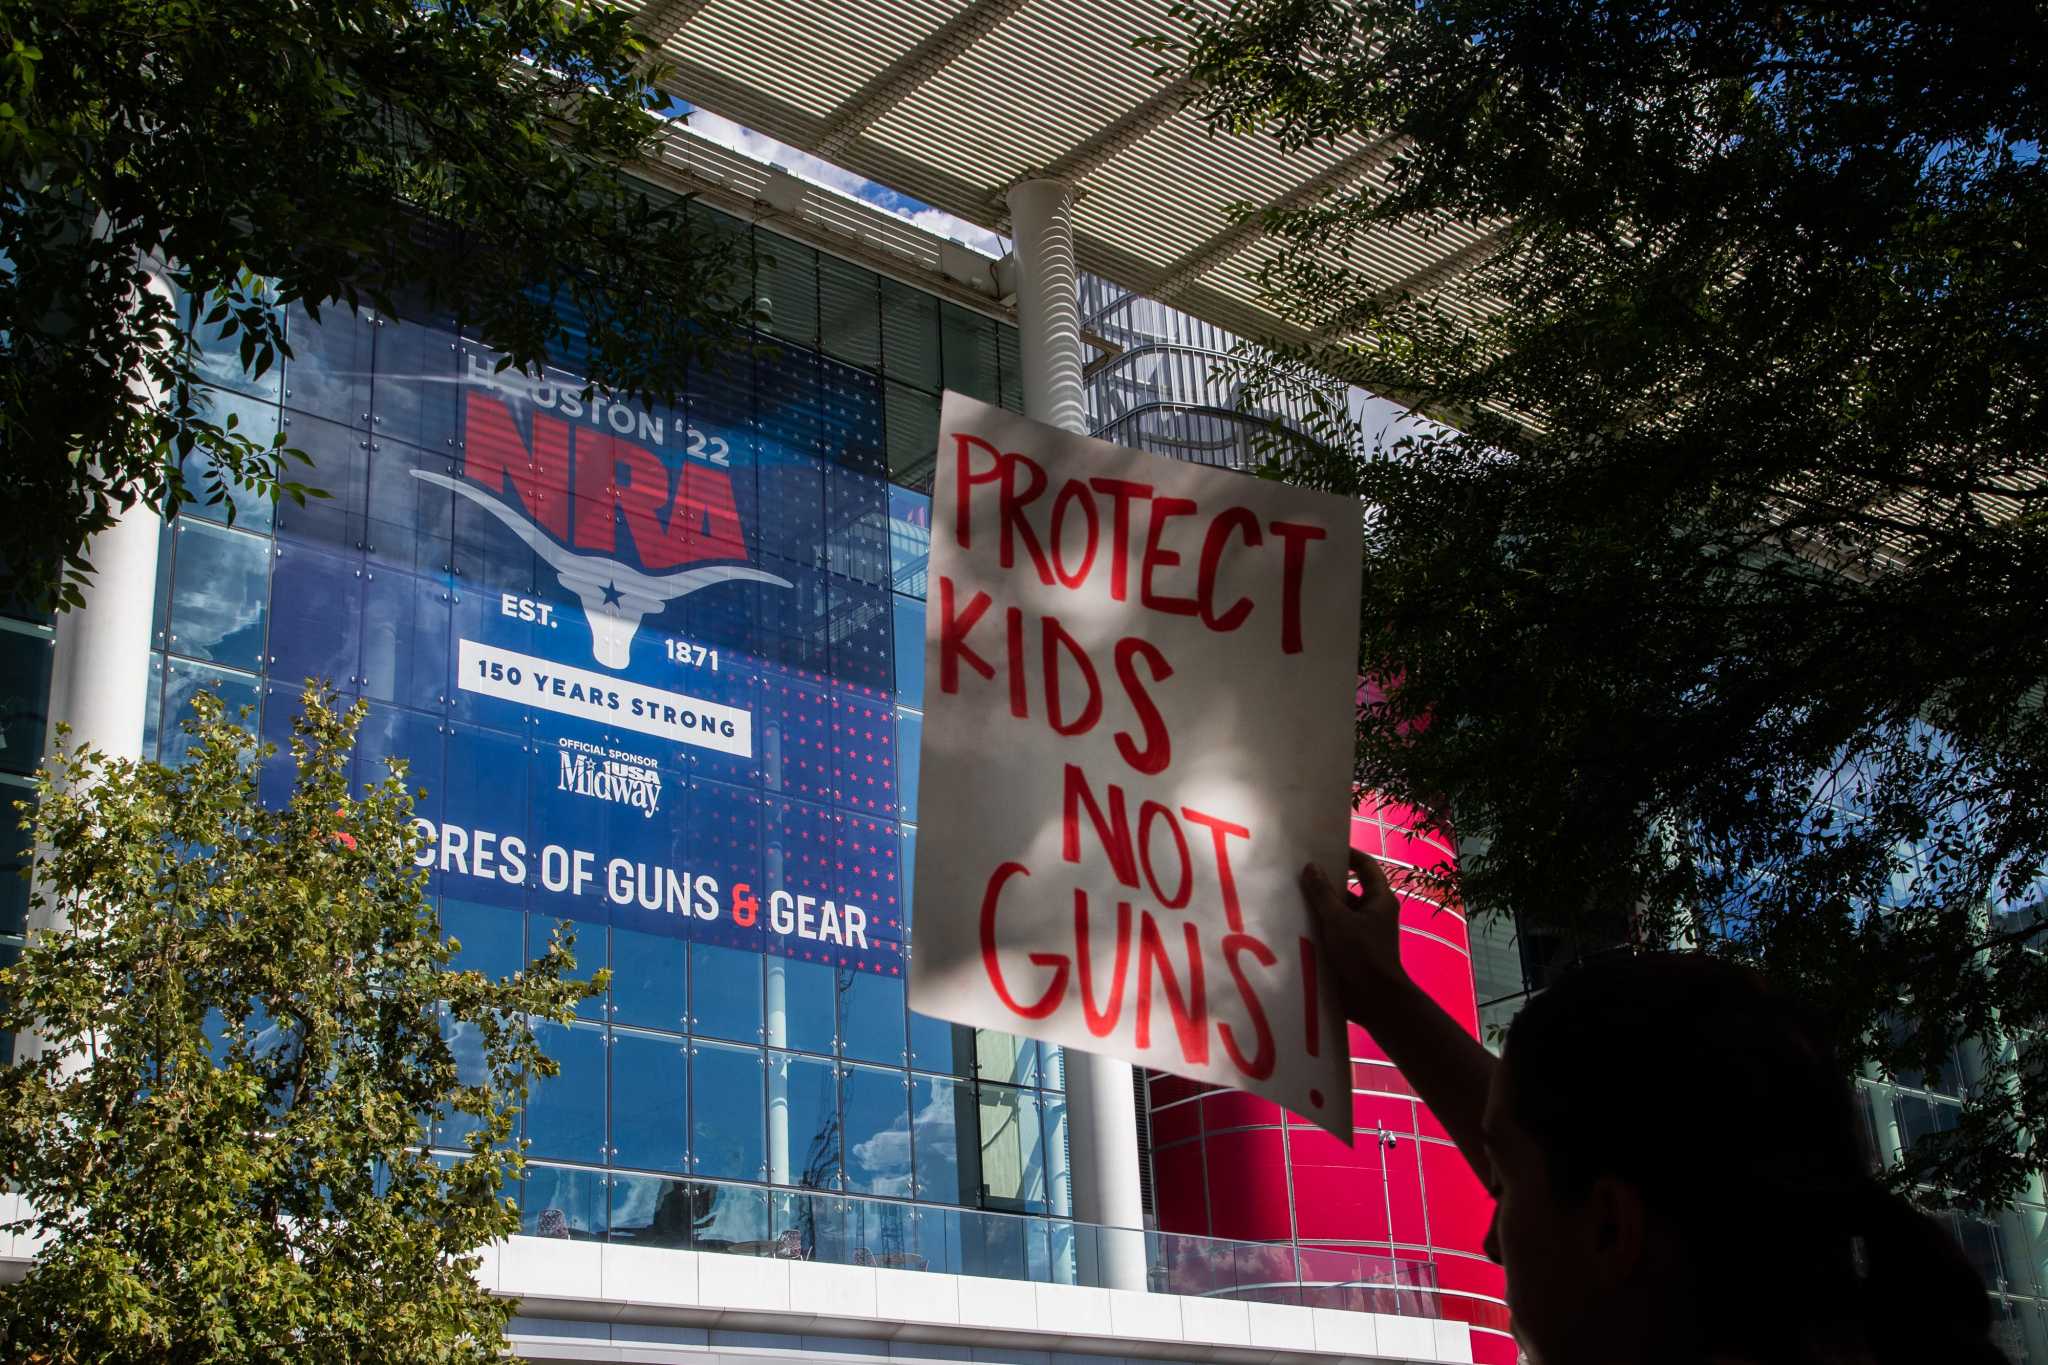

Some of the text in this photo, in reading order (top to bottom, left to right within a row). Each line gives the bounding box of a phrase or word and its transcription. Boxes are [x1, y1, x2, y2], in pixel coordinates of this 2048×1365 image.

[464, 390, 748, 568] NRA
[950, 433, 1327, 655] PROTECT
[502, 594, 558, 629] EST.
[665, 639, 719, 671] 1871
[938, 576, 1171, 775] KIDS
[478, 660, 736, 738] 150 YEARS STRONG
[559, 737, 658, 769] OFFICIAL SPONSOR
[611, 762, 661, 785] USA
[400, 817, 527, 885] CRES
[540, 844, 595, 896] OF
[607, 857, 719, 921] GUNS
[732, 883, 758, 927] &
[769, 889, 869, 950] GEAR
[1063, 763, 1250, 933] NOT
[979, 861, 1325, 1109] GUNS!
